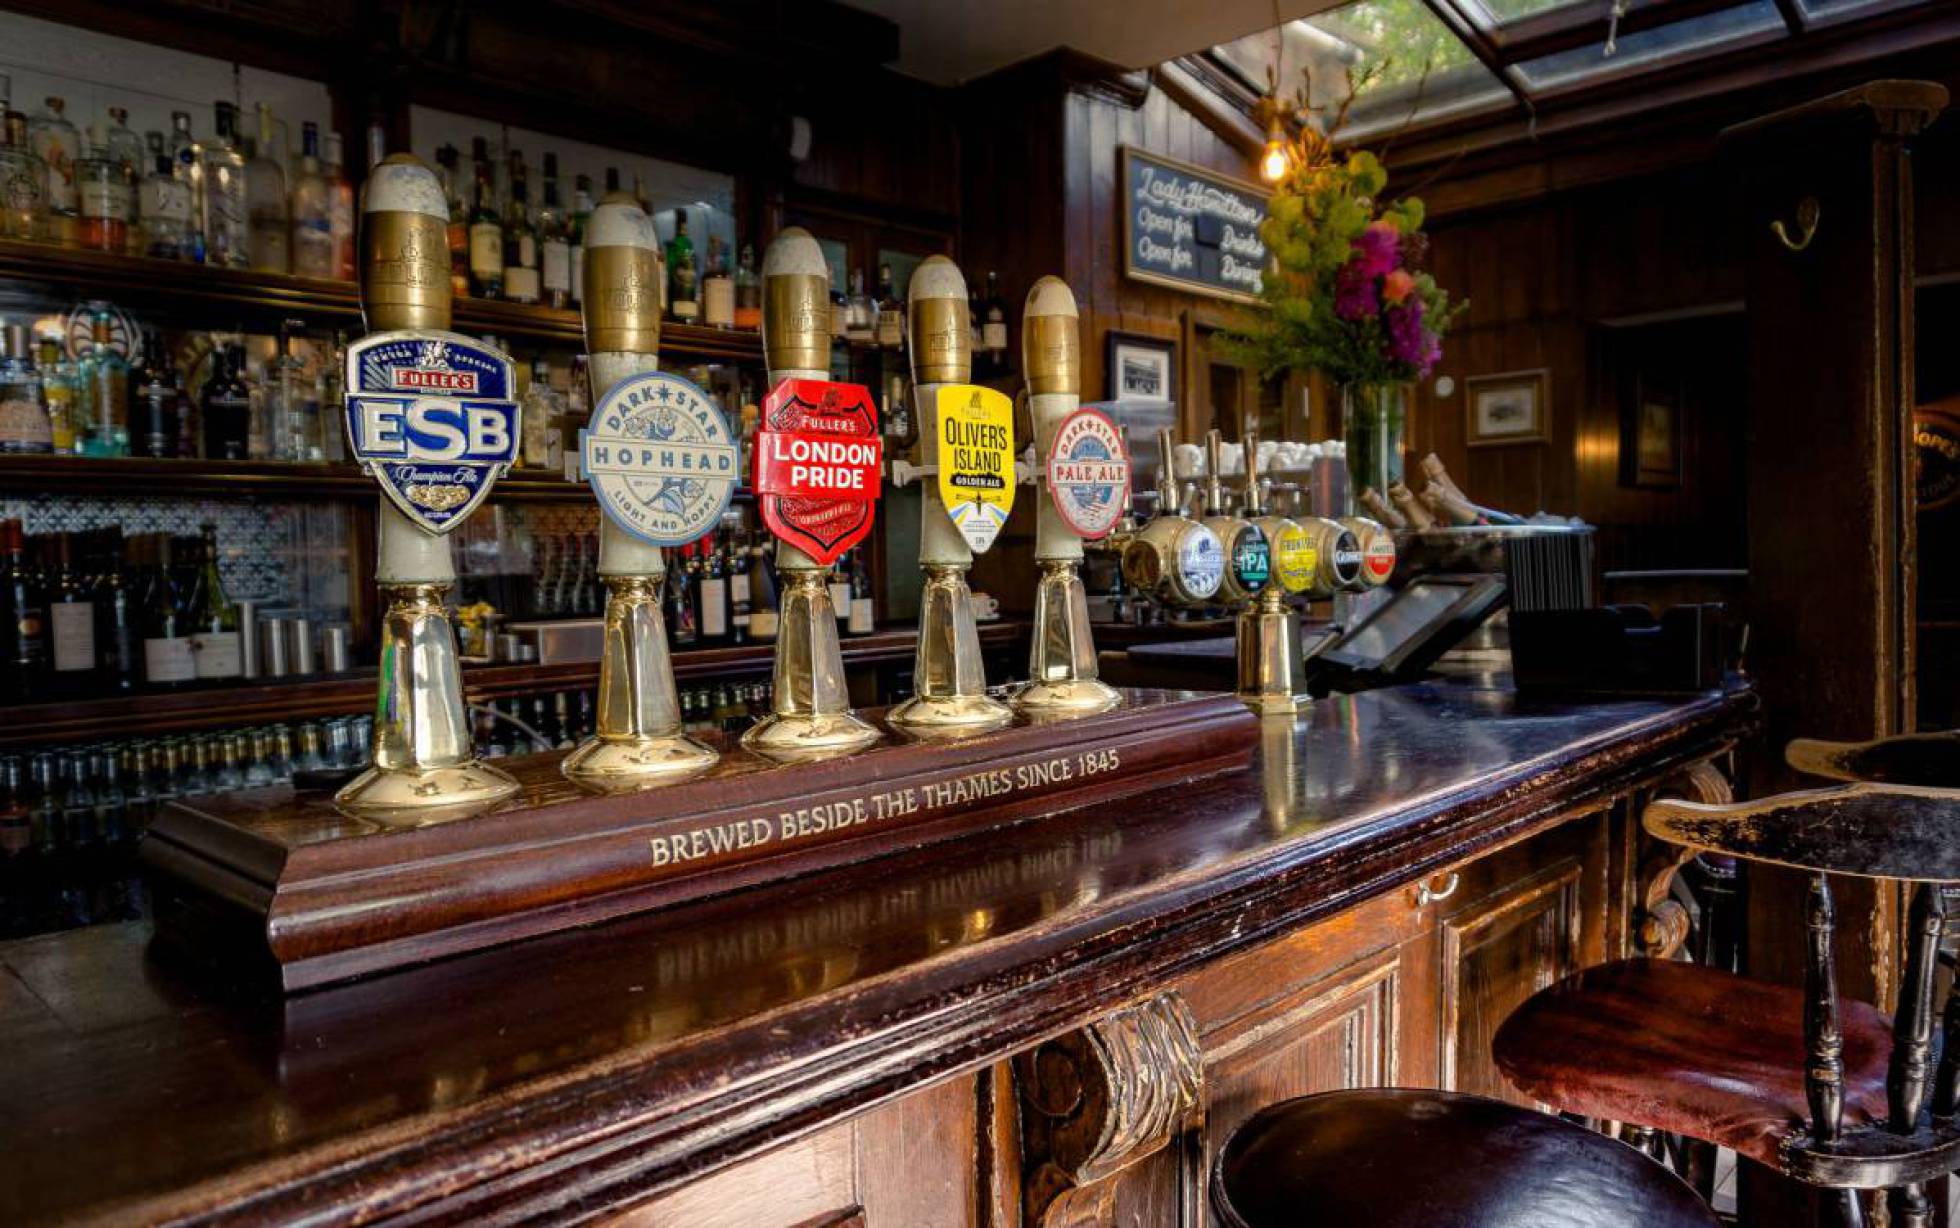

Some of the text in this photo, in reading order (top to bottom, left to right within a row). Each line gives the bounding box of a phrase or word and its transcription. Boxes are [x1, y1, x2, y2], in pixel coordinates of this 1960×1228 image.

[1138, 206, 1173, 233] Open
[1138, 235, 1173, 261] Open
[399, 371, 472, 389] FULLER'S
[606, 386, 718, 438] DARK STAR
[361, 398, 510, 461] ESB
[594, 446, 730, 471] HOPHEAD
[774, 439, 876, 466] LONDON
[954, 447, 1001, 473] ISLAND
[791, 465, 864, 489] PRIDE
[1057, 465, 1124, 481] PALE ALE
[652, 519, 677, 529] AND
[1241, 550, 1268, 572] IPA
[650, 749, 1121, 867] BREWED BESIDE THE THAMES SINCE 1845
